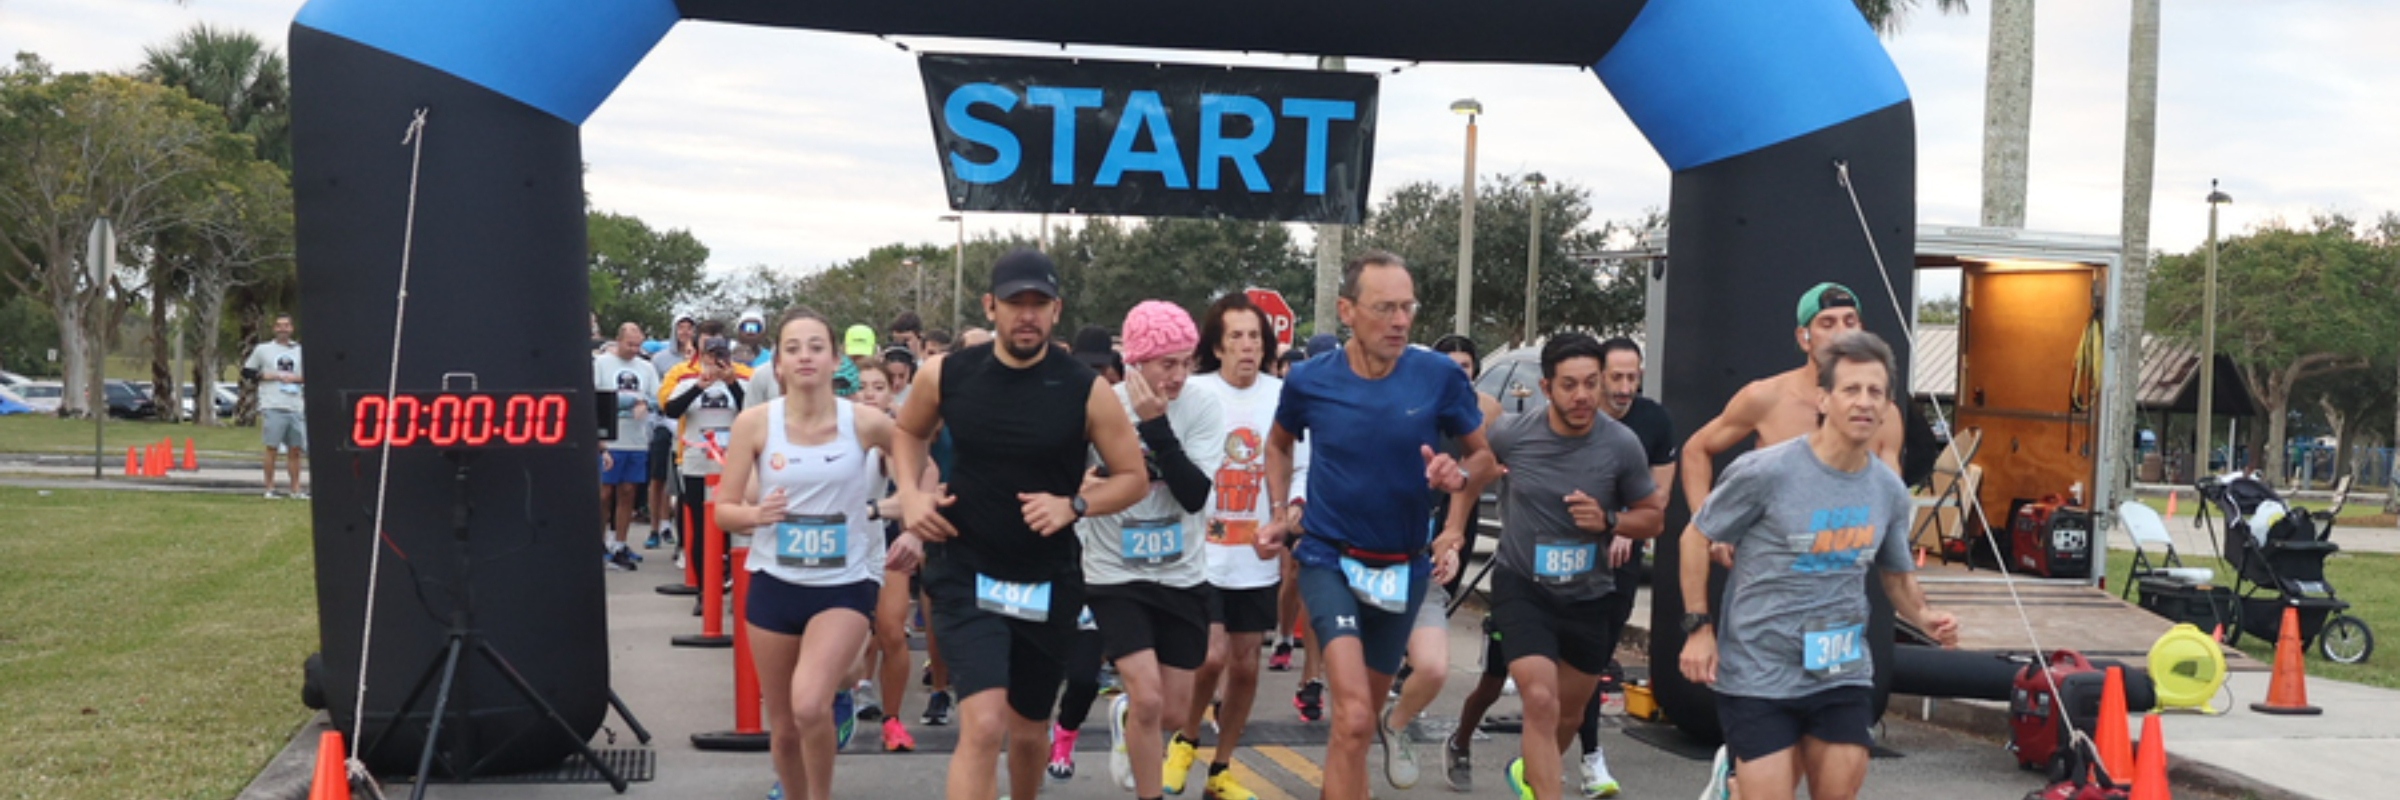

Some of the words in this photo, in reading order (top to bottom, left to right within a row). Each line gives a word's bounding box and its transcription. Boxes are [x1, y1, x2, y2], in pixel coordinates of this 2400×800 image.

[943, 82, 1356, 195] START
[352, 394, 569, 447] 00:00.00
[787, 527, 837, 555] 205
[1132, 529, 1175, 555] 203
[1811, 524, 1876, 555] RUN
[1546, 548, 1588, 573] 858
[1817, 631, 1855, 665] 304
